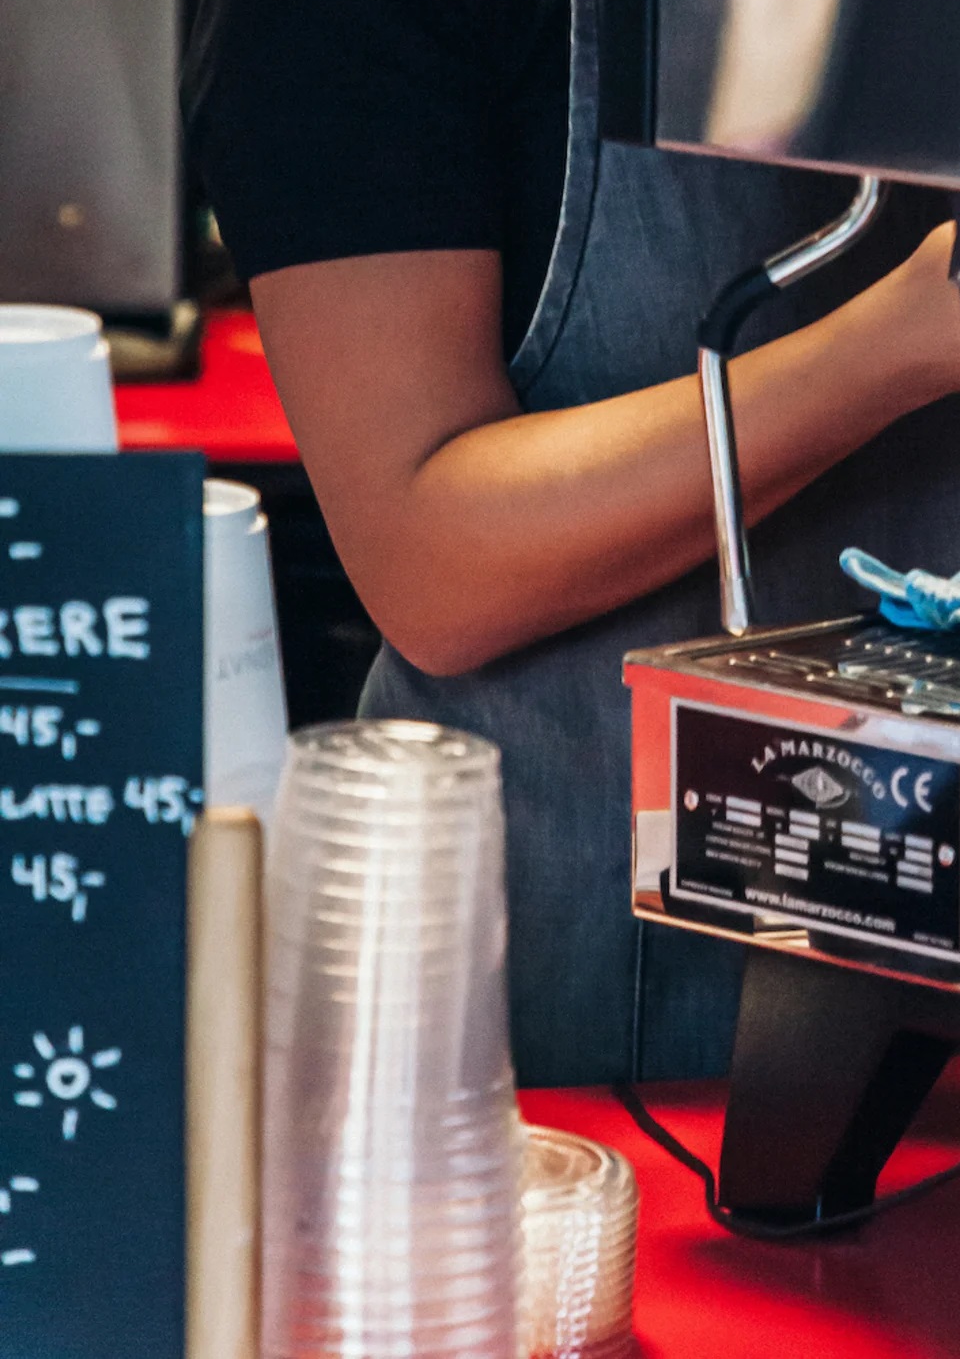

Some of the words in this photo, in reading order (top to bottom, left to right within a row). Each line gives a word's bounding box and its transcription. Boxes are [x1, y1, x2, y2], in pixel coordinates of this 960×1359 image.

[751, 745, 777, 773] LA
[780, 739, 886, 800] MARZOCCO
[11, 850, 106, 923] 45,-
[744, 887, 896, 933] www.lamarzocco.com
